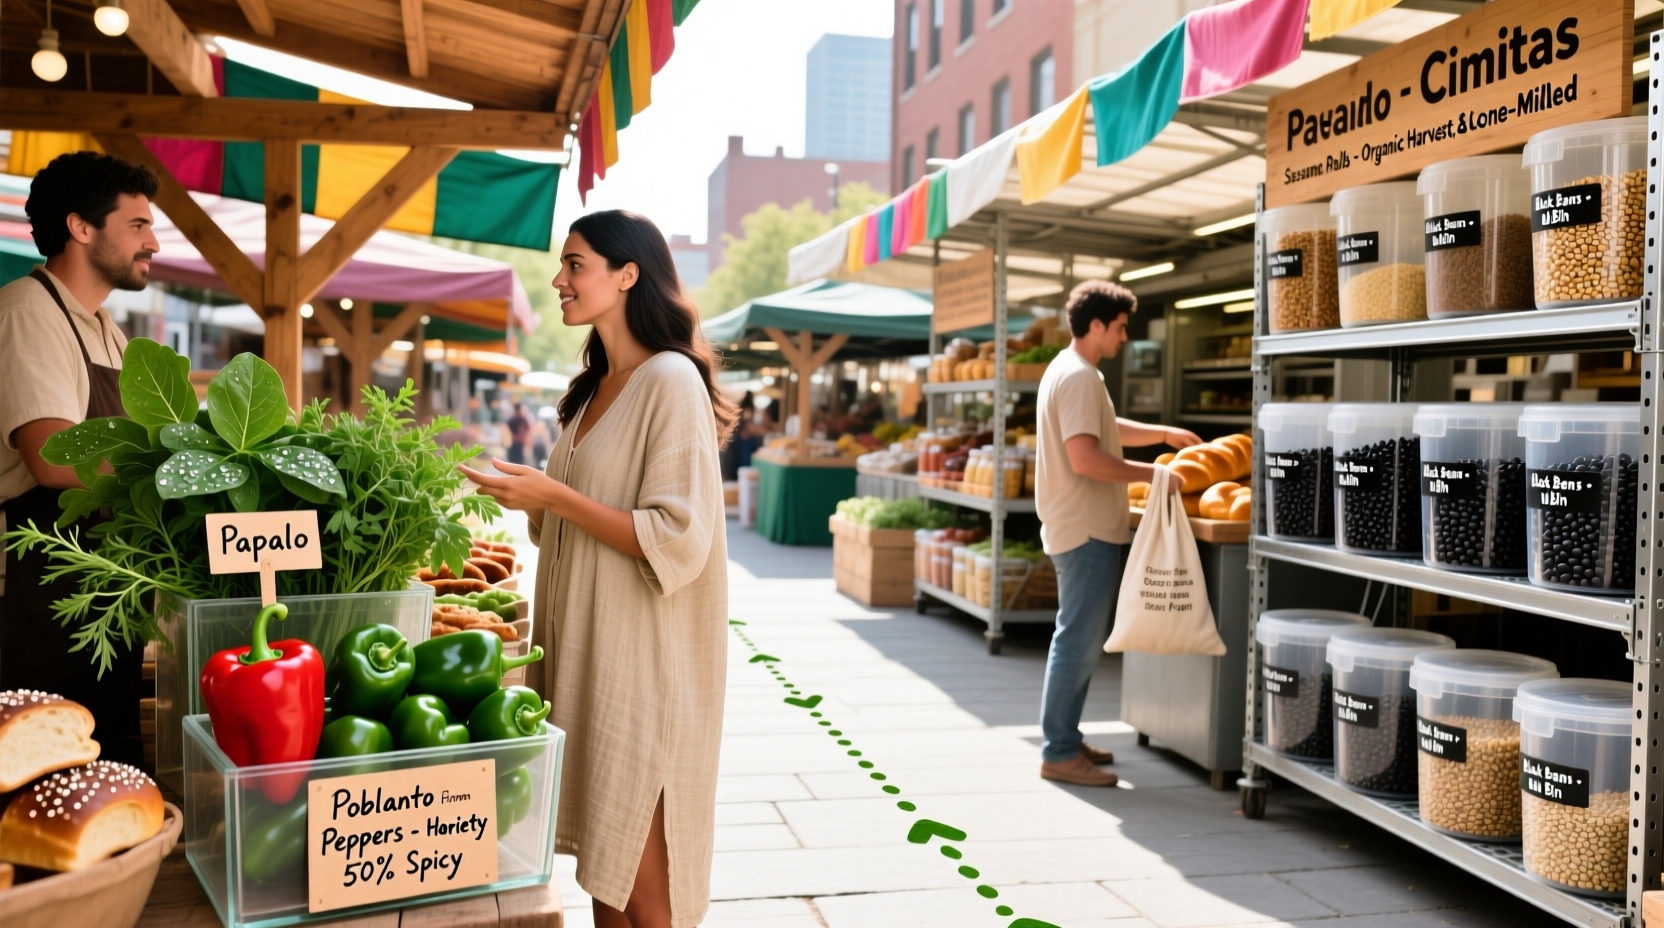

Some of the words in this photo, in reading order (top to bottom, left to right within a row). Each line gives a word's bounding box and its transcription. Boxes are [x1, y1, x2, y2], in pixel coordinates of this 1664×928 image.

[1420, 17, 1580, 104] Cimitas
[1361, 134, 1404, 166] Organic
[221, 523, 309, 563] Papalo
[332, 785, 435, 820] Poblanto
[321, 827, 404, 860] Peppers
[343, 853, 395, 887] 50%
[406, 850, 463, 883] Spicy
